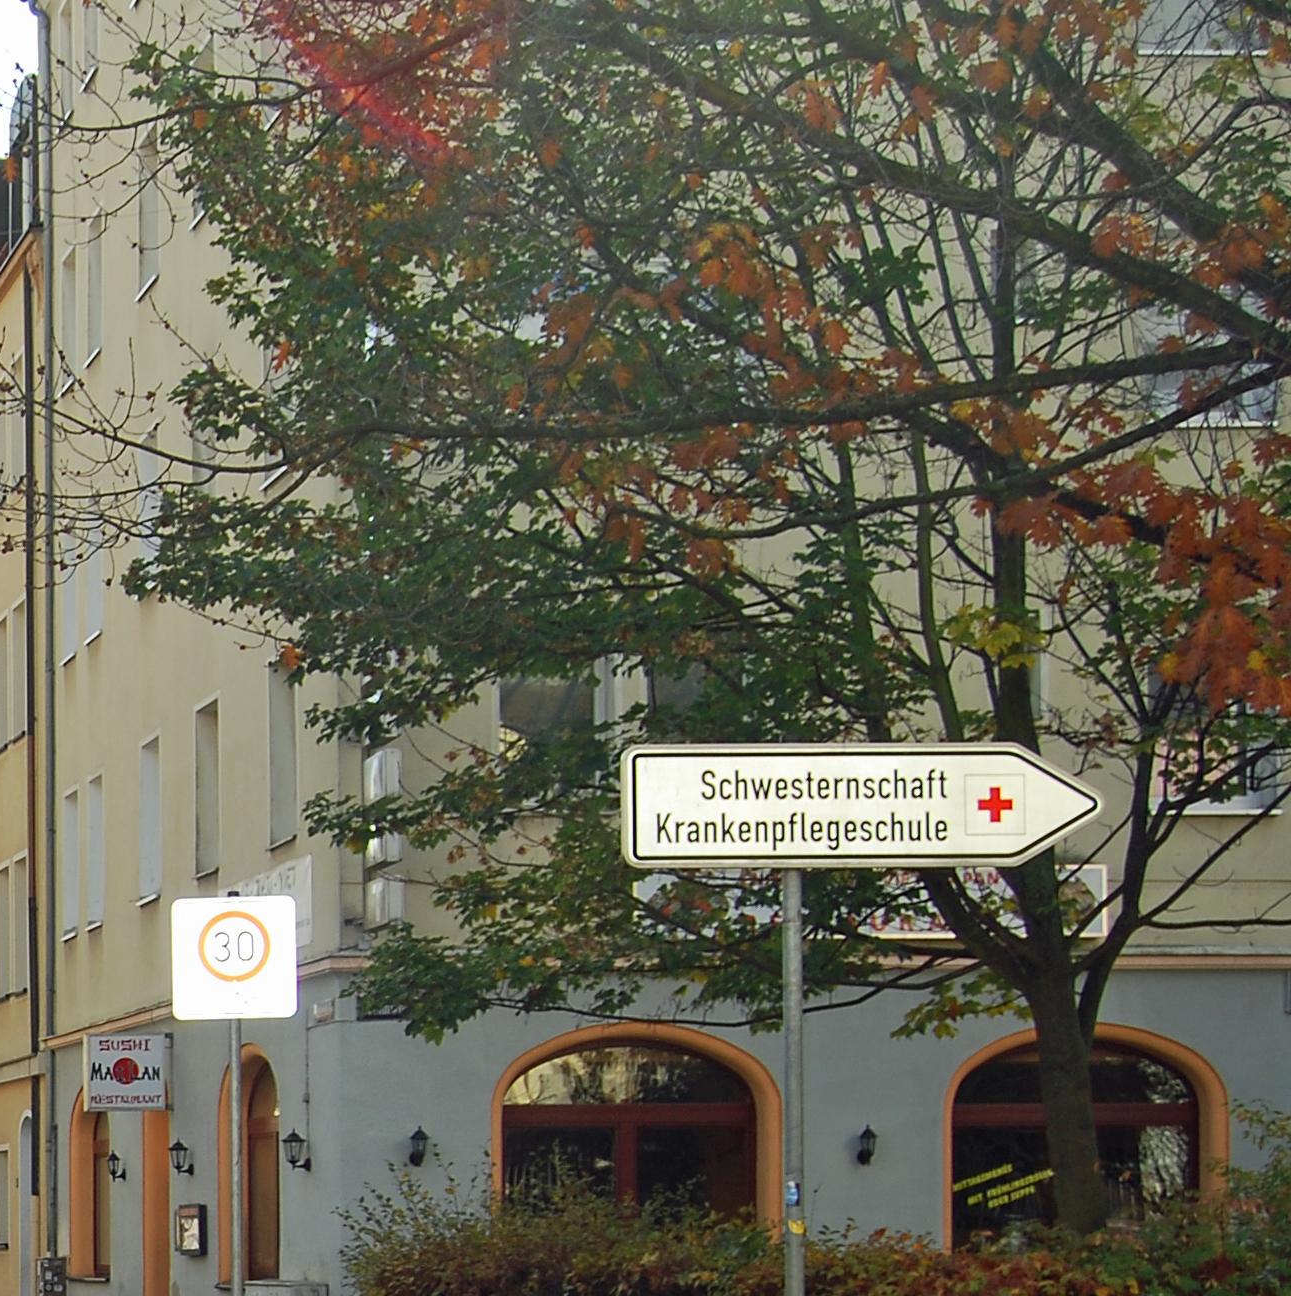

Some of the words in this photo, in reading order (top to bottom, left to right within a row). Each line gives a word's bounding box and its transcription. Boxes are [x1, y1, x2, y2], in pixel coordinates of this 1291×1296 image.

[700, 769, 948, 800] Schwesternschaft
[656, 811, 948, 851] Krankenpflegeschule
[214, 931, 254, 962] 30
[98, 1038, 152, 1052] SUSHI
